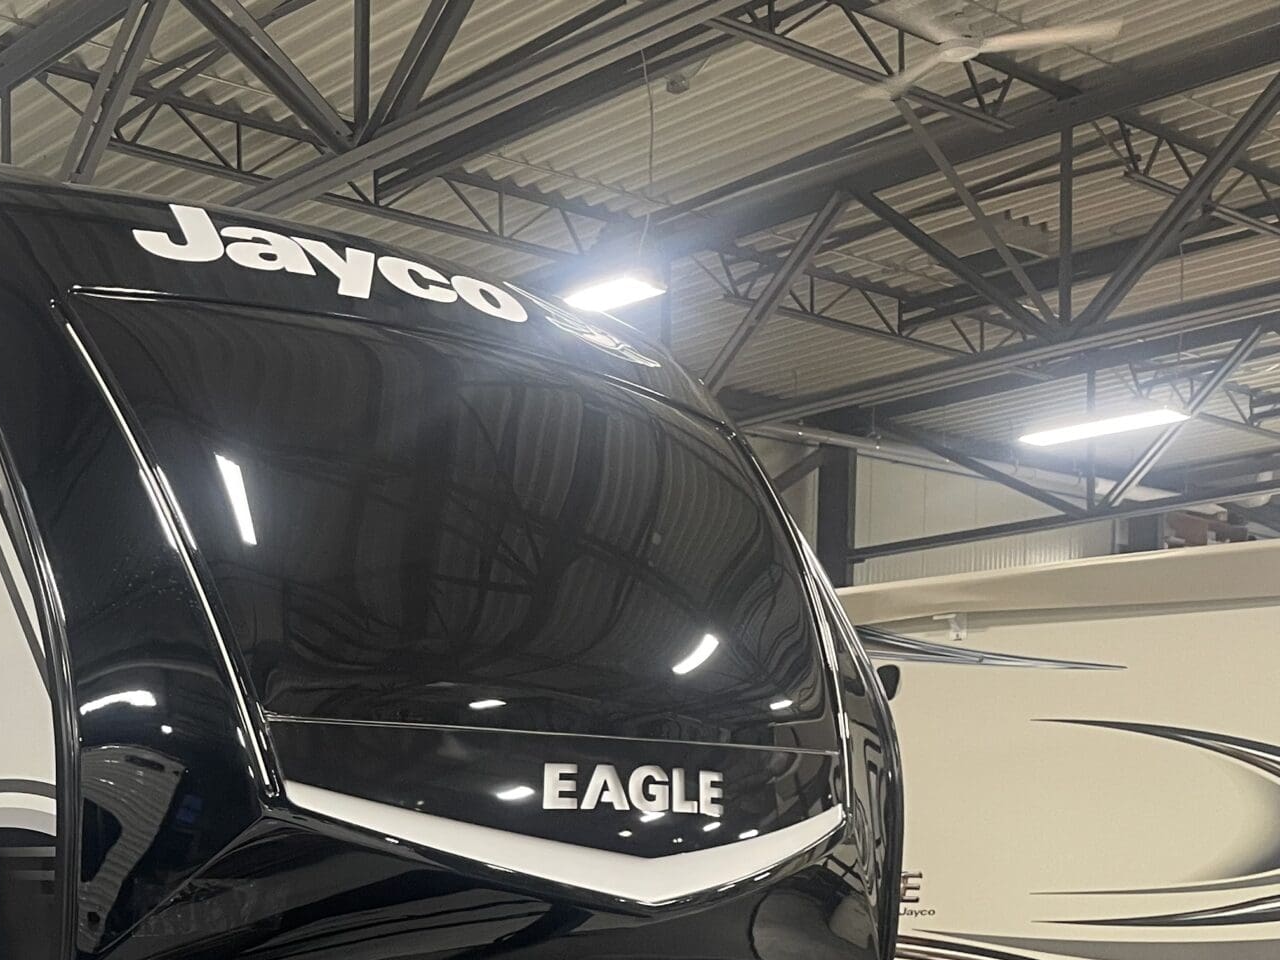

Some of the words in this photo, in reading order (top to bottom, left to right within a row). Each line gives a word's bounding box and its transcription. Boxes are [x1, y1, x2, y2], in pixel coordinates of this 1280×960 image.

[132, 203, 528, 322] Jayco
[543, 763, 724, 817] EAGLE
[899, 907, 936, 917] Jayco
